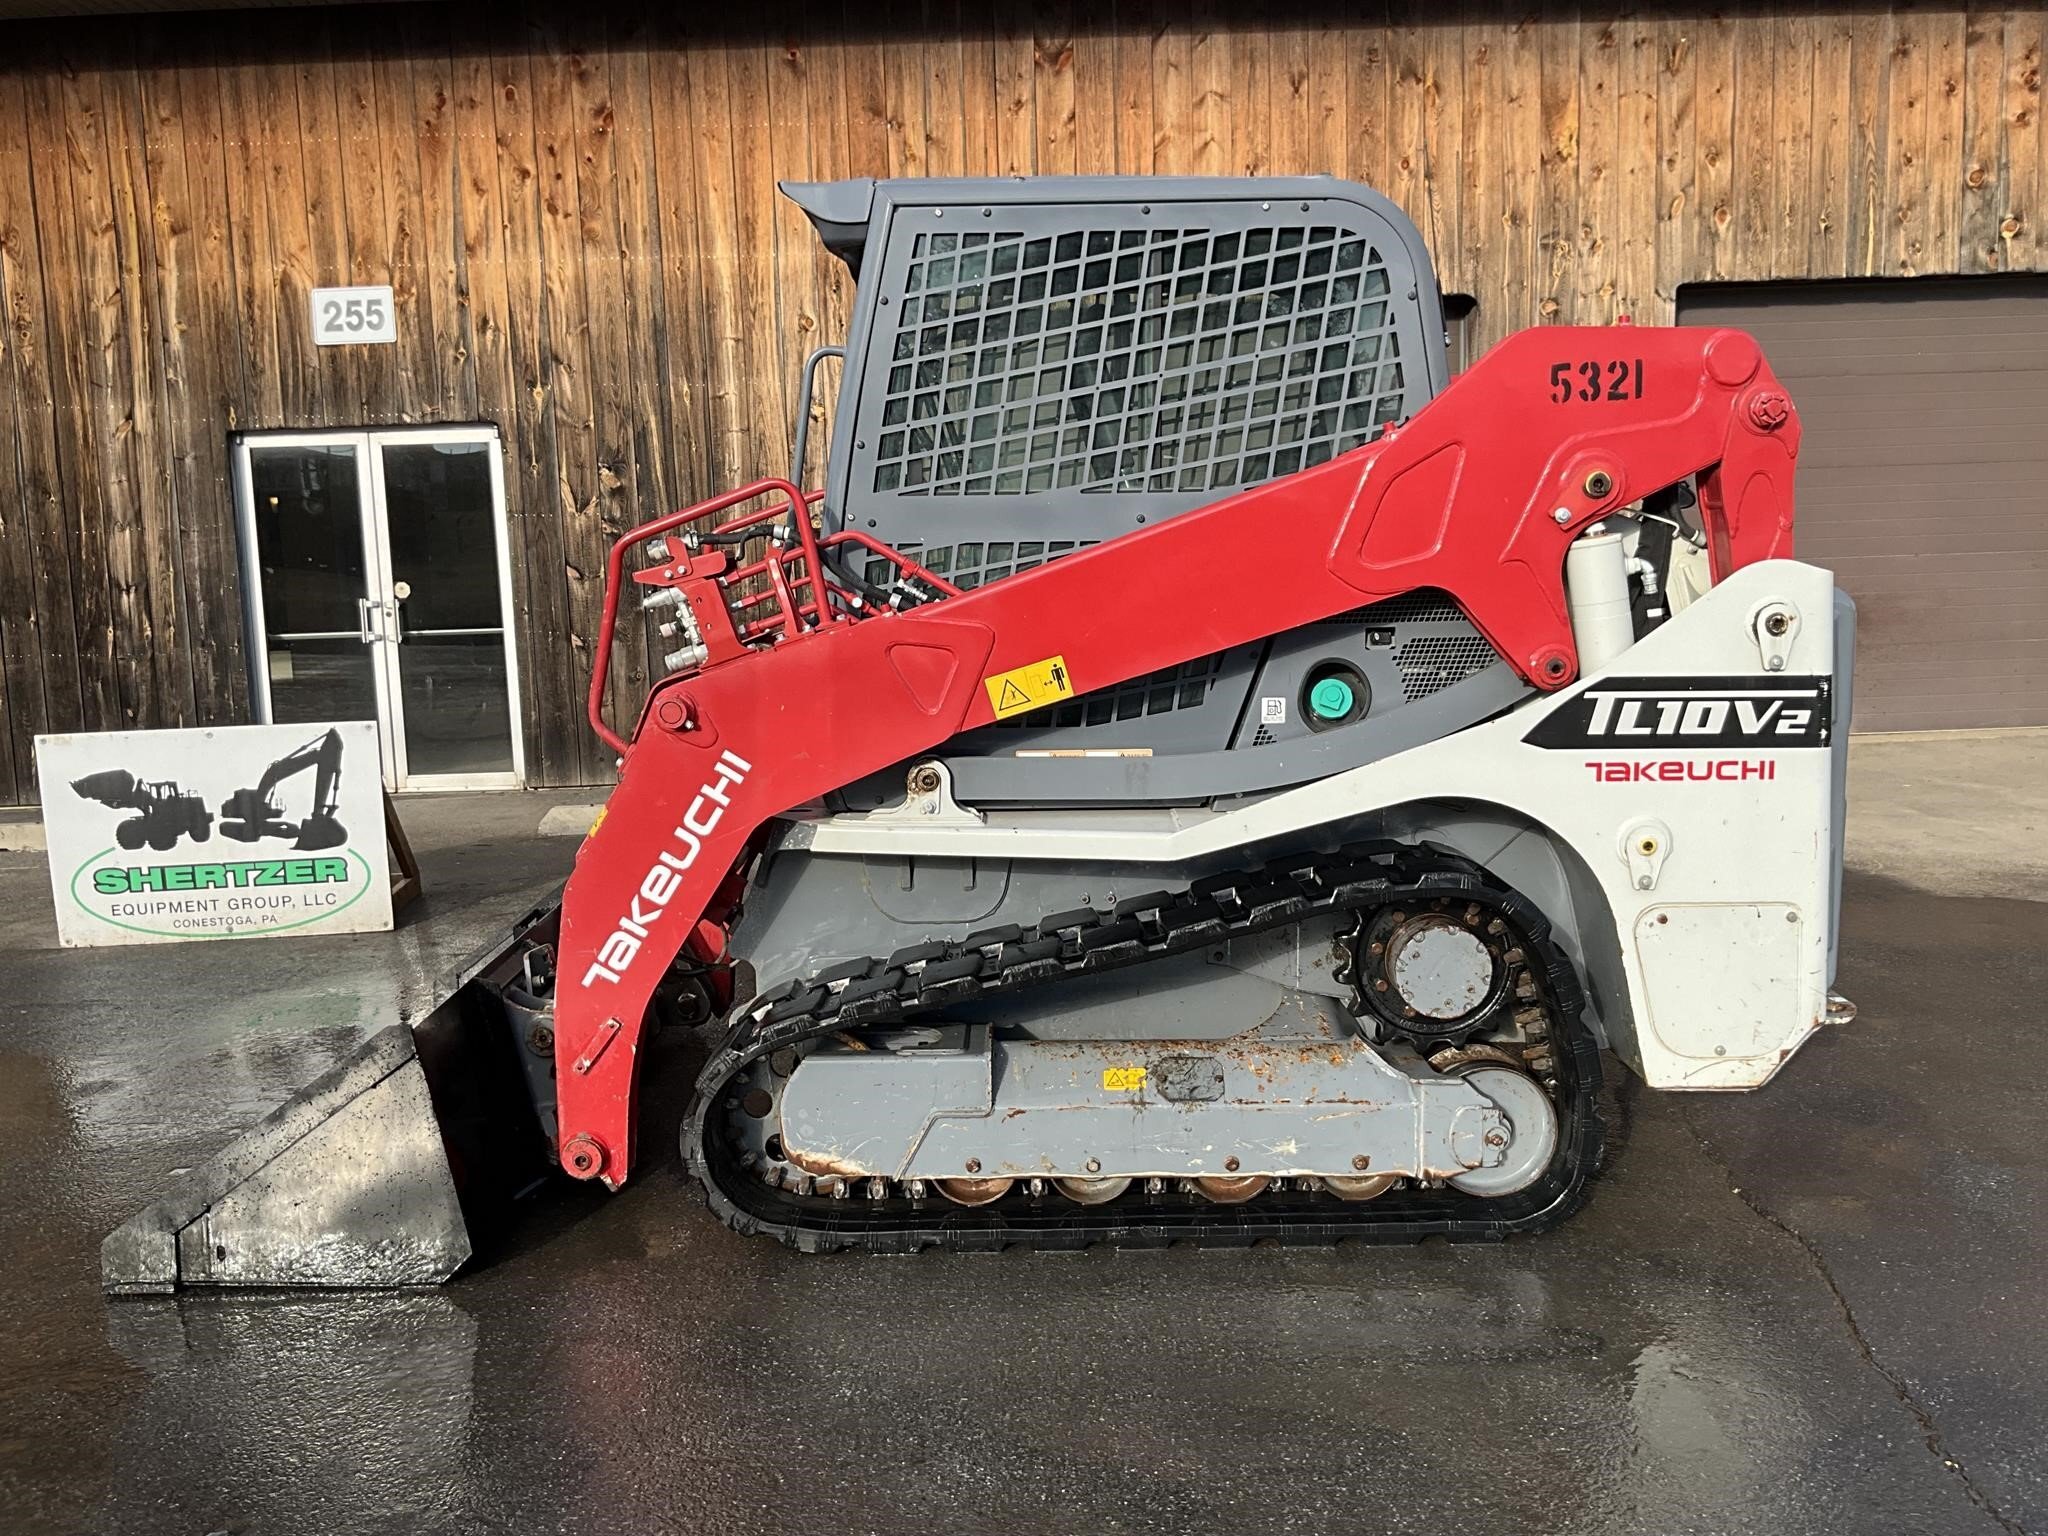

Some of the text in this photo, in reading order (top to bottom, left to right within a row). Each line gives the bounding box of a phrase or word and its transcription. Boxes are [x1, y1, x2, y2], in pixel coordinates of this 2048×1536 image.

[323, 299, 385, 332] 255
[1550, 358, 1644, 404] 5321
[1583, 689, 1818, 735] TL10V2
[93, 857, 349, 895] SHERTZER
[111, 892, 338, 917] EQUIPMENT GROUP, LLC
[173, 914, 278, 929] CONESTOGA, PA
